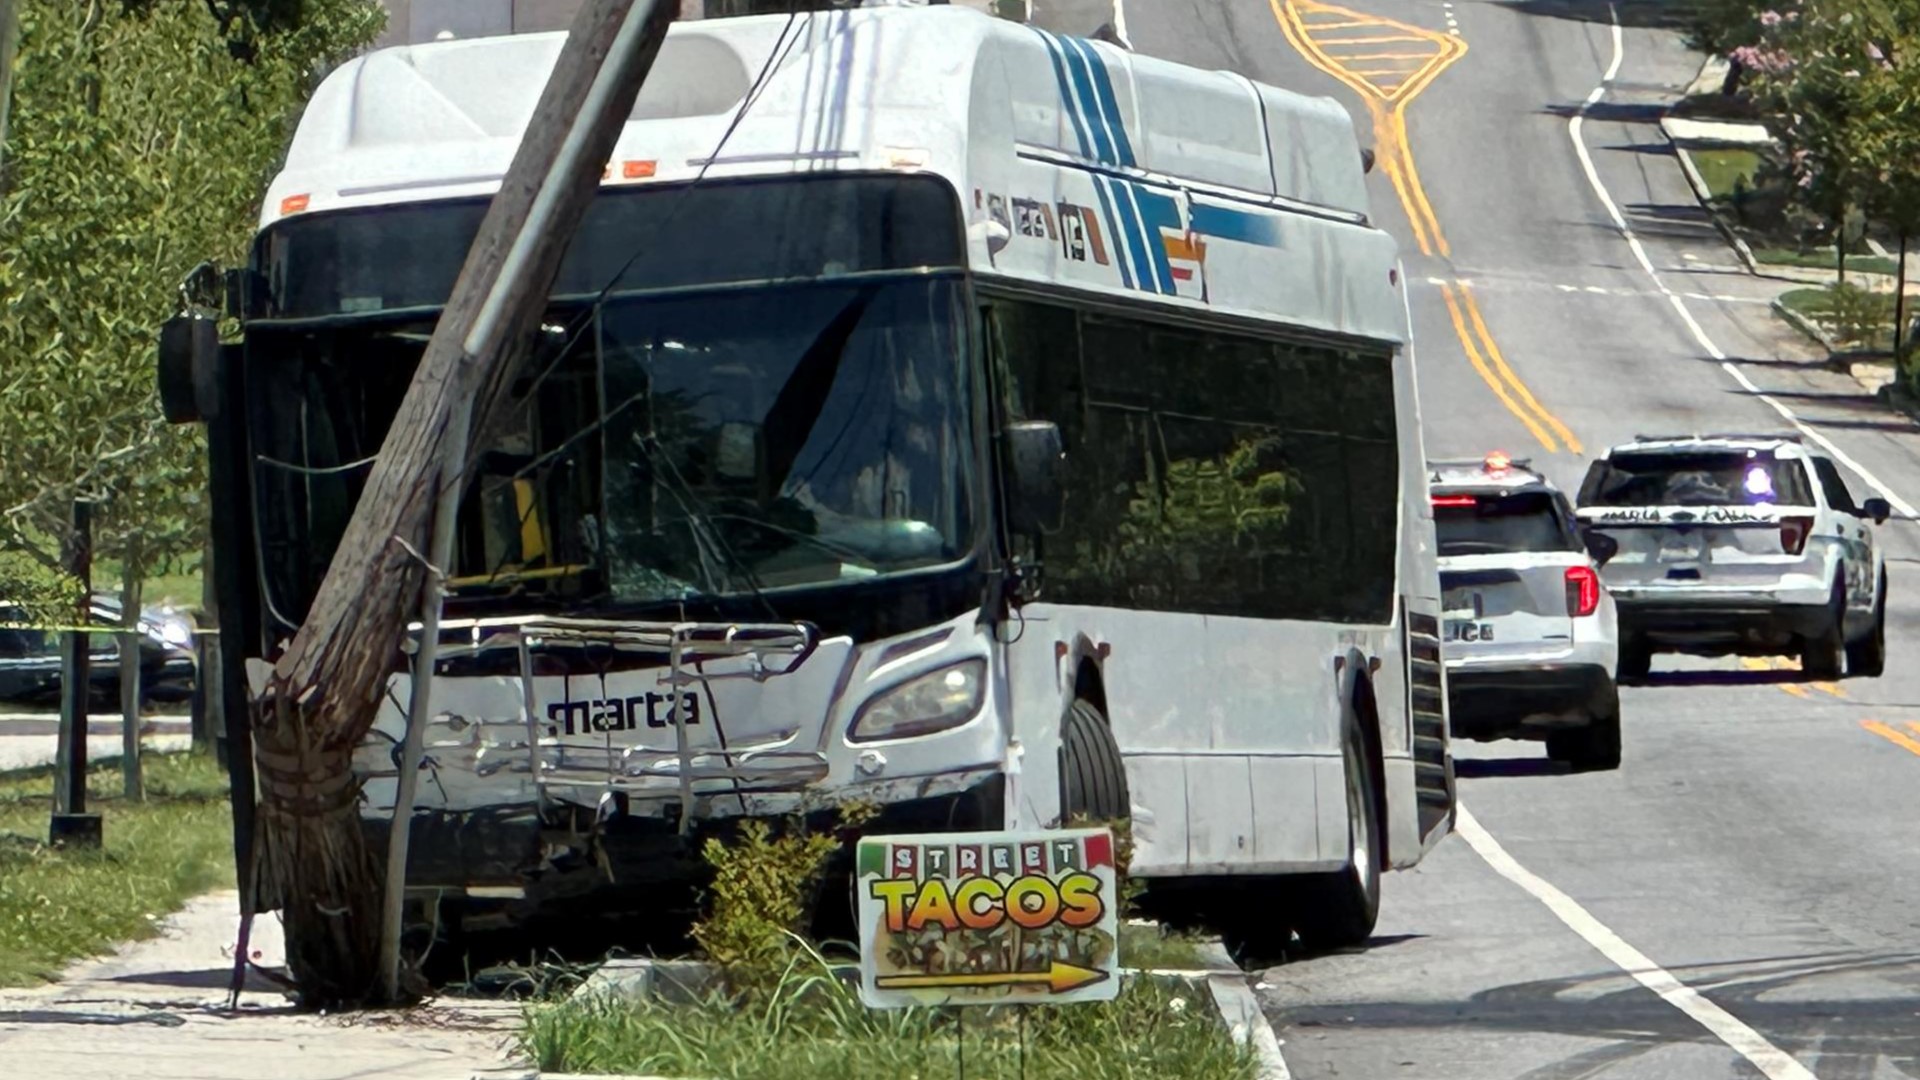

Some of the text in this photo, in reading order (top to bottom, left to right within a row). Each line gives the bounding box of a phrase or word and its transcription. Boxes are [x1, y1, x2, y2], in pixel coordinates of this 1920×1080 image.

[547, 692, 699, 735] marta
[896, 844, 1074, 869] STREET
[871, 874, 1105, 932] TACOS
